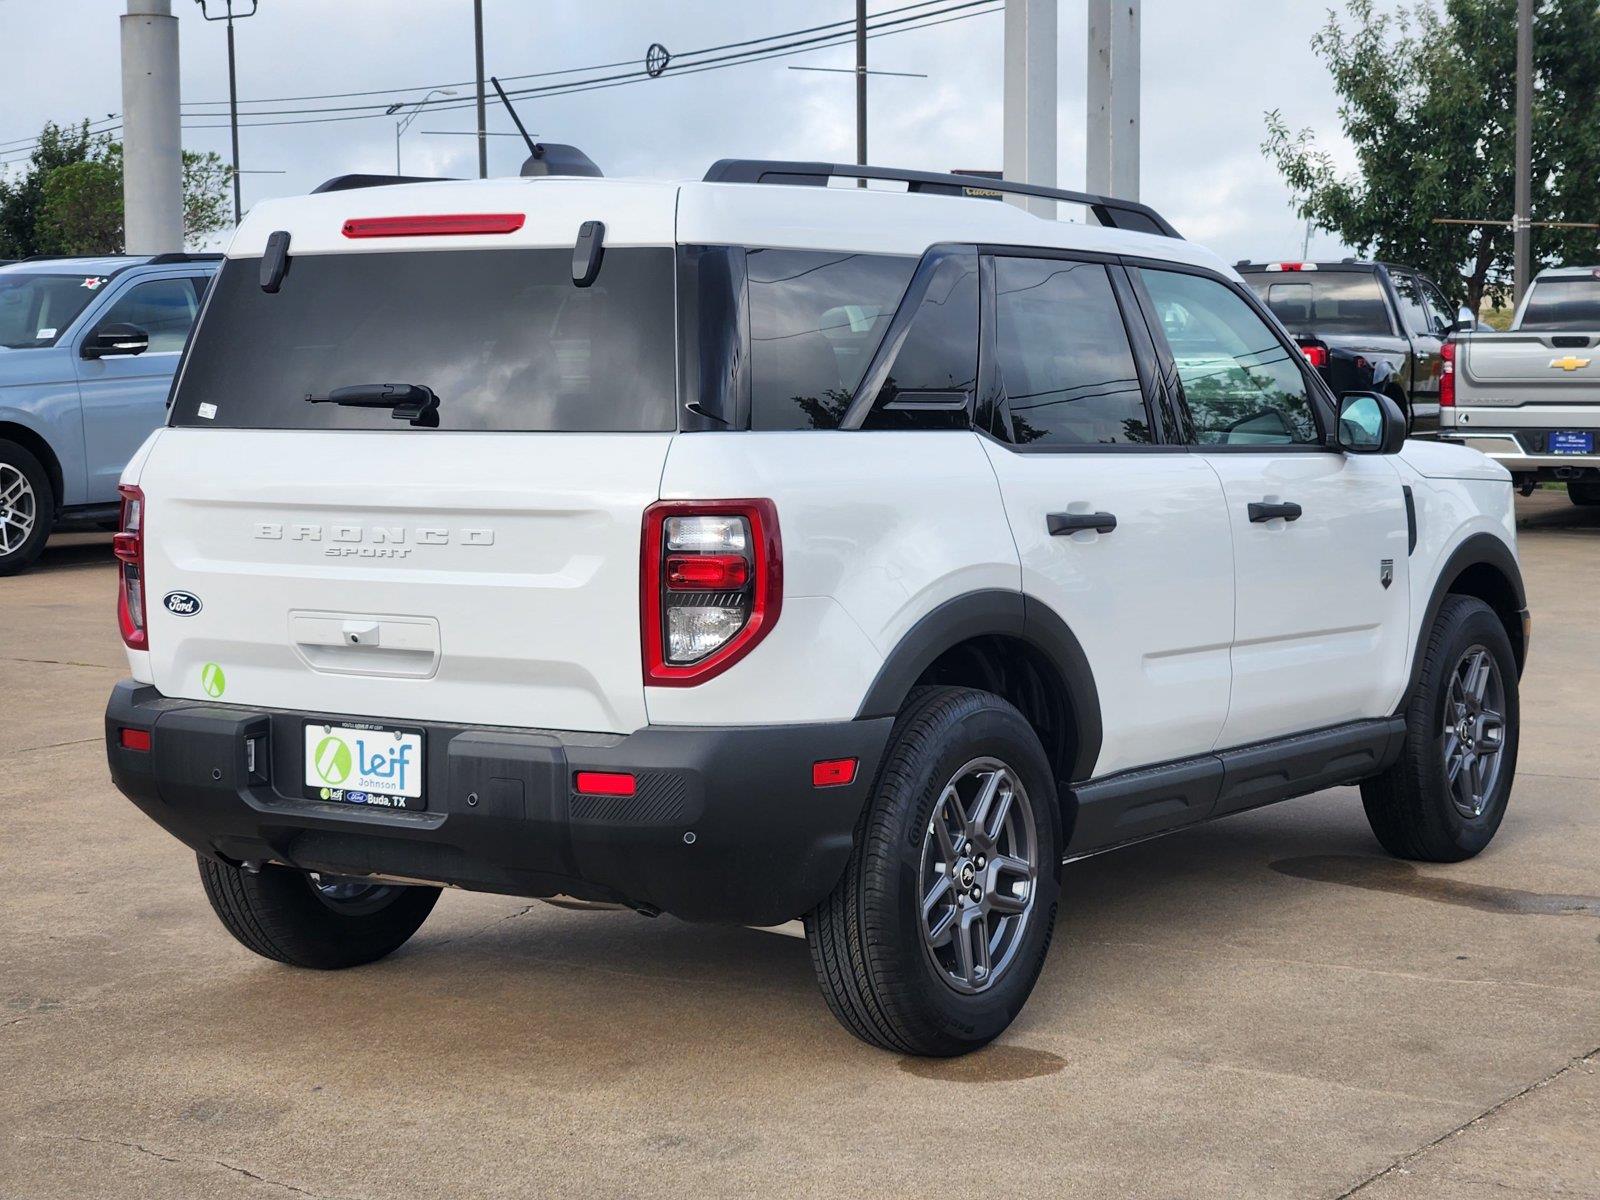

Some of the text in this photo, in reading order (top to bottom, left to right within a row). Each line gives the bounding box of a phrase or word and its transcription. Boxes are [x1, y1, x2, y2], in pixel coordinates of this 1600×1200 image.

[254, 523, 495, 546] BRONCO
[324, 547, 411, 558] SPORT
[168, 594, 194, 612] Ford
[358, 777, 396, 790] Johnson
[367, 794, 391, 806] Buda,
[392, 796, 406, 808] TX
